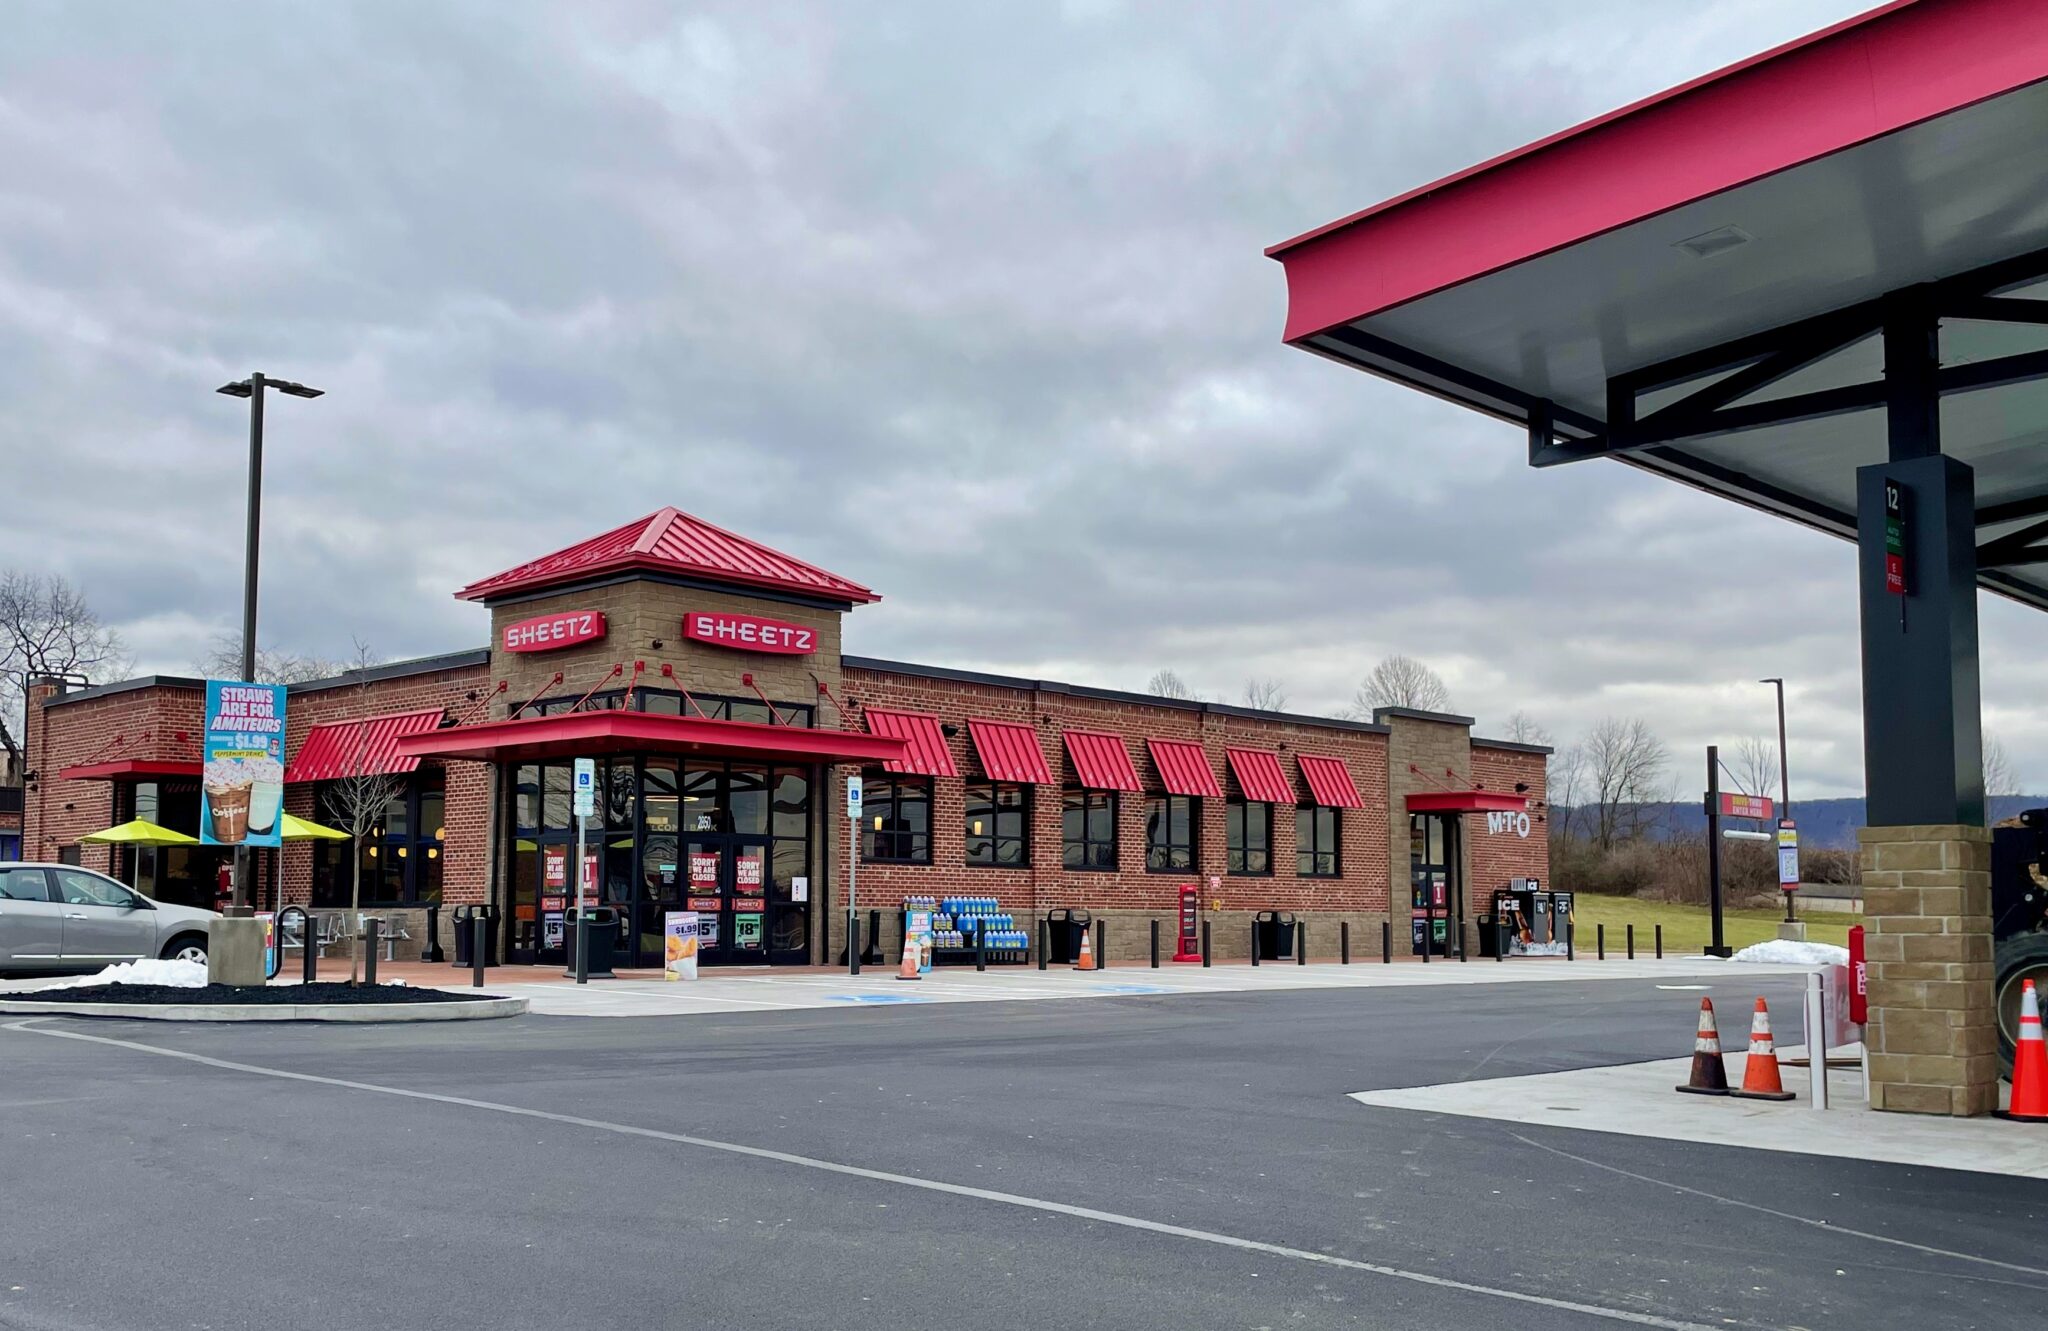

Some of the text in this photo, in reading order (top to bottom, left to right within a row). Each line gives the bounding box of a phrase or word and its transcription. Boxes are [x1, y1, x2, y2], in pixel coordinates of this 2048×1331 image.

[1887, 486, 1899, 510] 12
[507, 615, 593, 648] SHEETZ
[697, 616, 811, 650] SHEETZ
[220, 686, 274, 704] STRAWS
[220, 701, 274, 718] ARE FOR
[209, 716, 282, 733] AMATEURS
[235, 732, 268, 750] $1.99
[546, 856, 565, 865] SORRY
[692, 857, 716, 867] SORRY
[737, 861, 760, 870] SORRY
[584, 863, 591, 881] 1
[692, 866, 716, 874] WE ARE
[737, 869, 760, 878] WE ARE
[691, 873, 716, 882] CLOSED
[737, 877, 760, 885] CLOSED
[1497, 899, 1520, 911] ICE
[675, 923, 697, 935] $1.99
